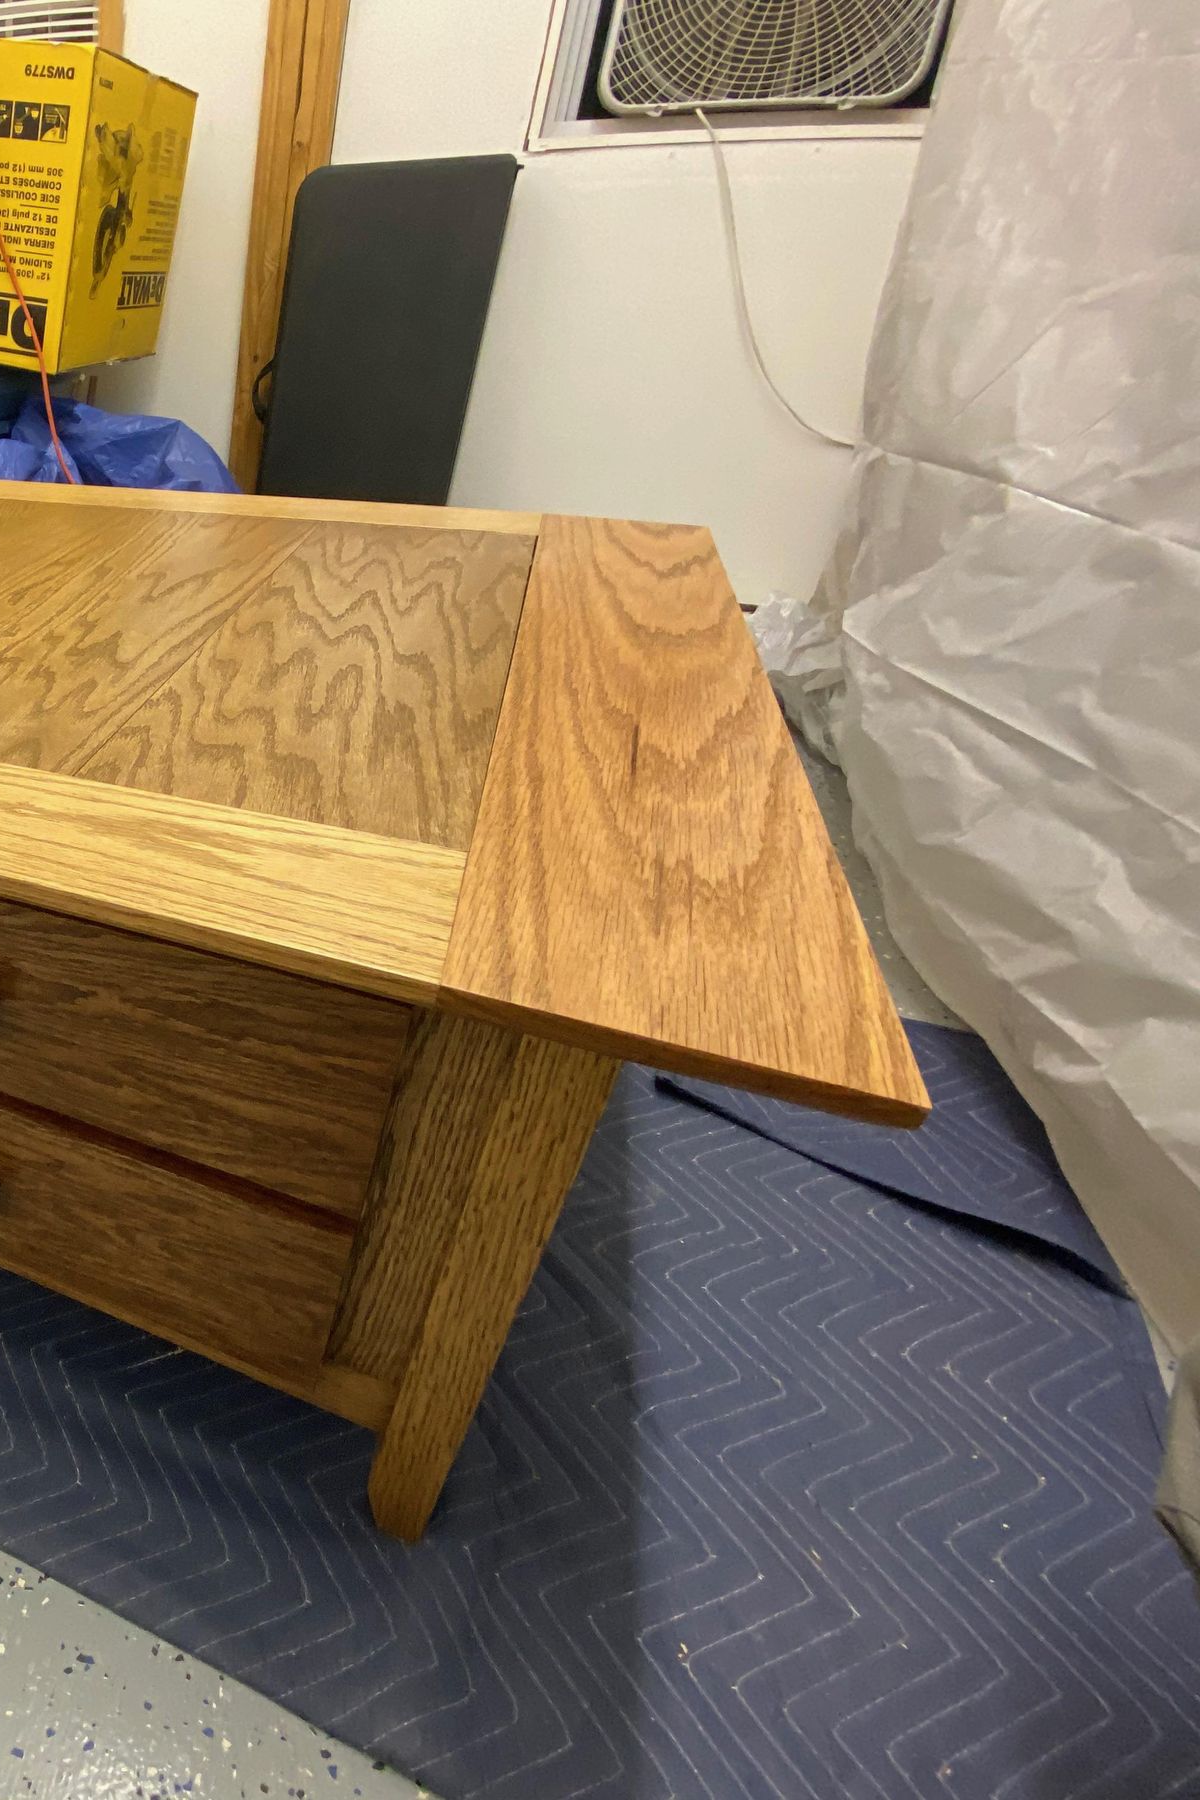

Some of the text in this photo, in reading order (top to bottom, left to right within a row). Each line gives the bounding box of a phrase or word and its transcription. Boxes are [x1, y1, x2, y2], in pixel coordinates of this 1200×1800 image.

[24, 64, 74, 80] DWS779
[12, 163, 26, 173] (12
[28, 165, 44, 174] mm
[47, 168, 64, 177] 305
[0, 176, 10, 184] ET
[40, 194, 60, 204] SCIE
[32, 213, 42, 222] 12
[46, 215, 57, 224] DE
[4, 223, 56, 236] DESLIZANTE
[24, 238, 55, 249] SIERRA
[19, 256, 52, 269] SLIDING
[16, 269, 34, 279] (305
[118, 275, 165, 306] DEWALT
